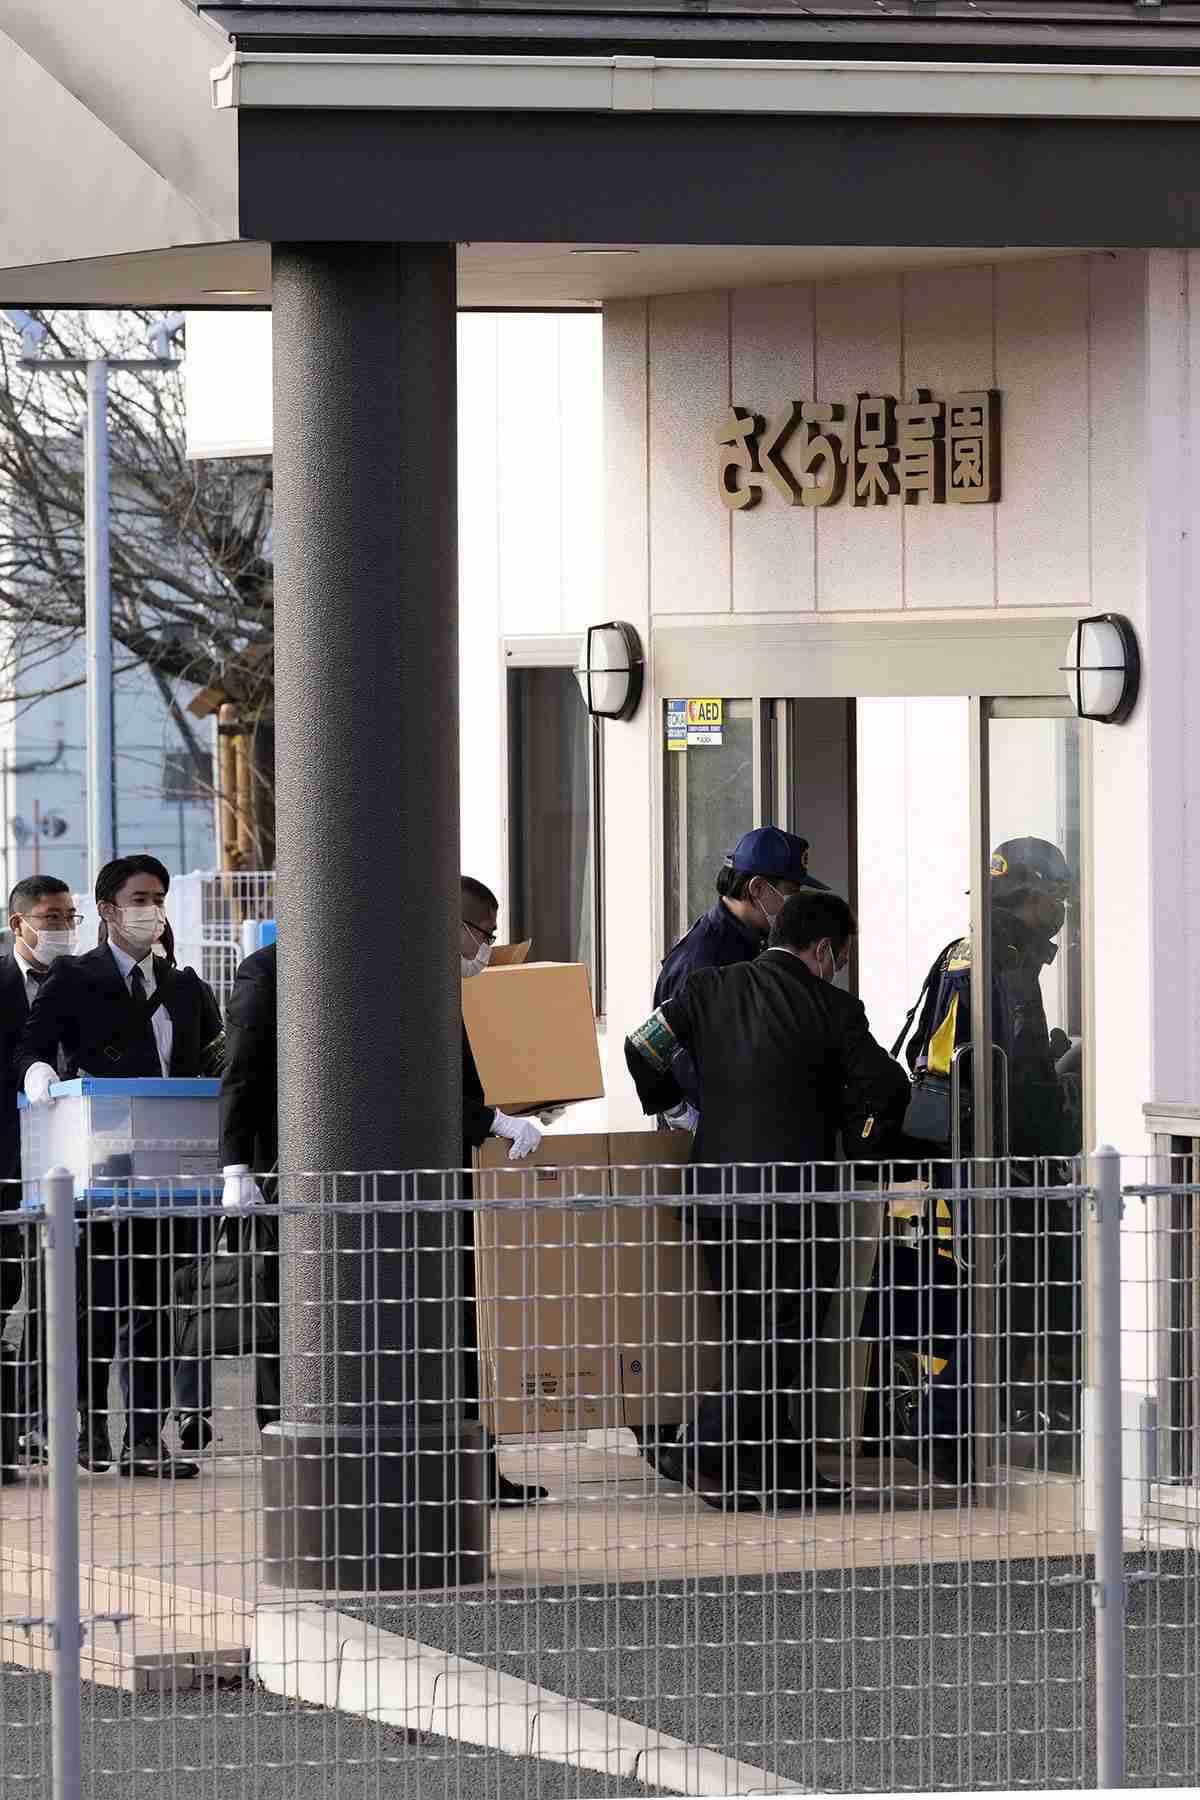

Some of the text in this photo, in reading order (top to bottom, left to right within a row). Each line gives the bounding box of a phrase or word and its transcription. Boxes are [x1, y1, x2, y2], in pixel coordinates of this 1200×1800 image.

[719, 387, 998, 511] さくら保育園
[698, 702, 719, 720] AED
